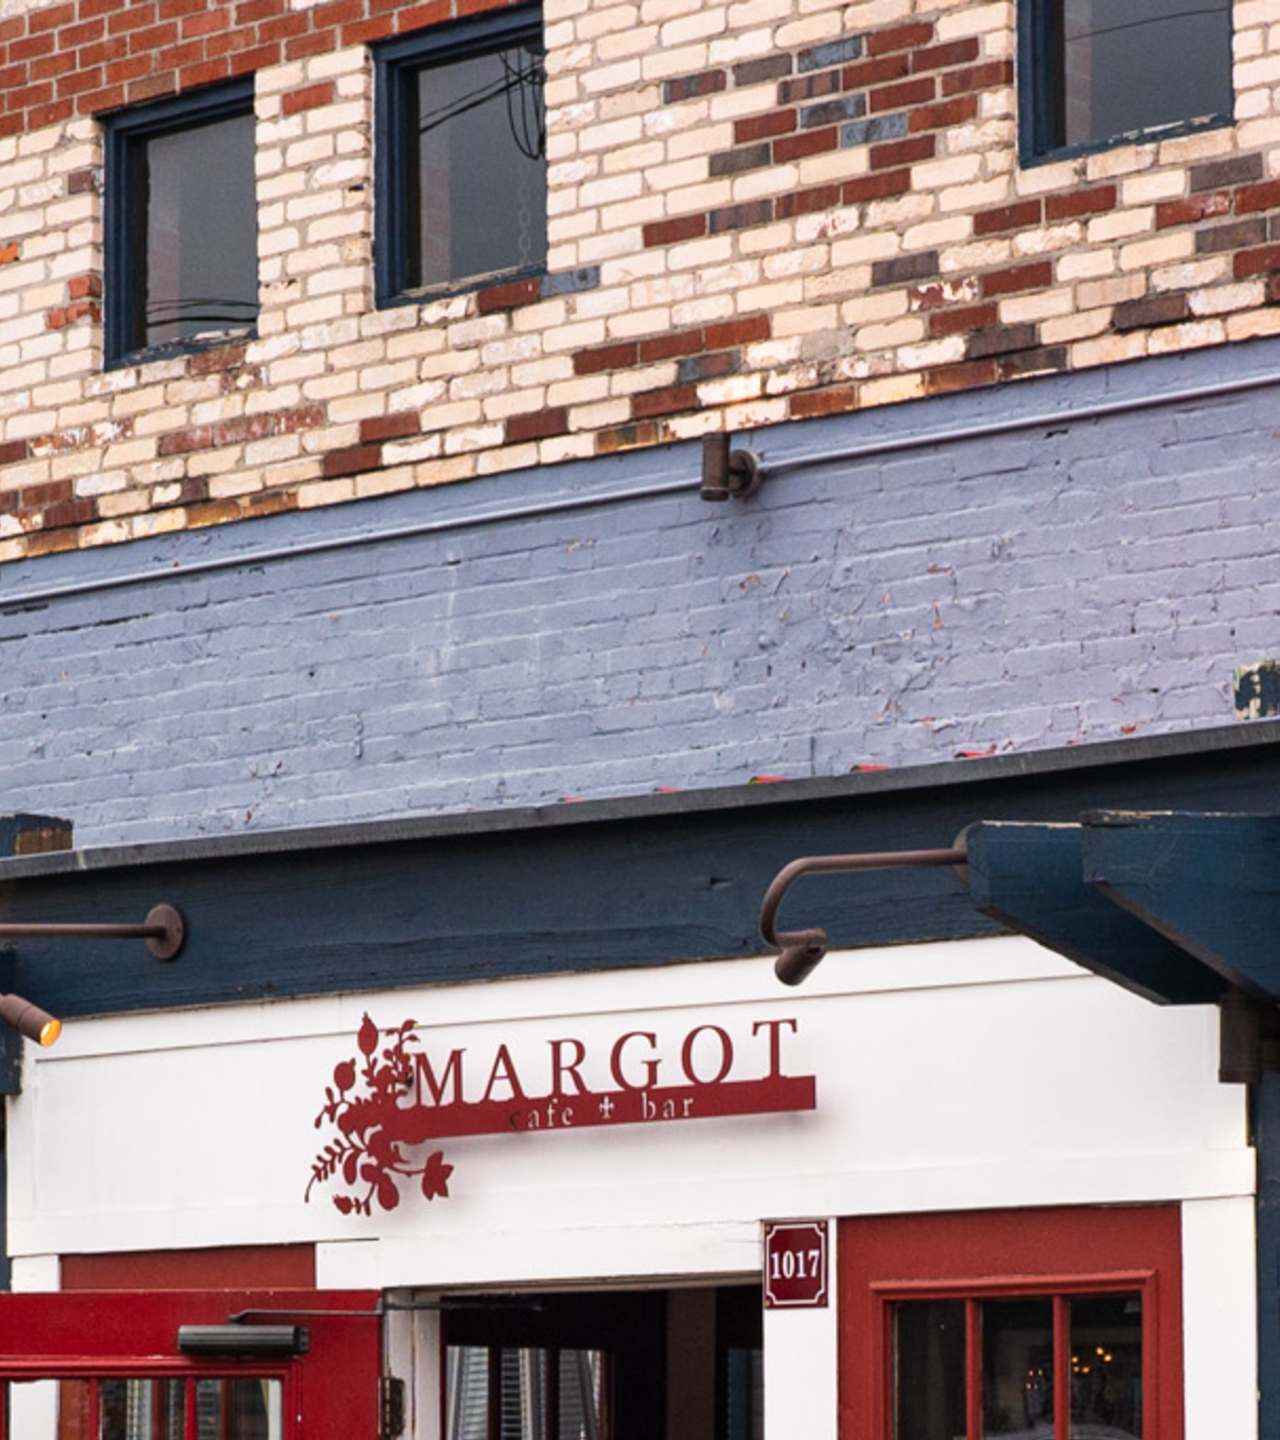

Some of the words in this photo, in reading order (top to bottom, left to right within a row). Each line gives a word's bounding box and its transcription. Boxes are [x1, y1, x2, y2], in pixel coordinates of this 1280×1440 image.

[412, 1018, 798, 1107] MARGOT
[509, 1098, 574, 1131] cafe
[641, 1090, 694, 1119] bar
[770, 1248, 821, 1280] 1017
